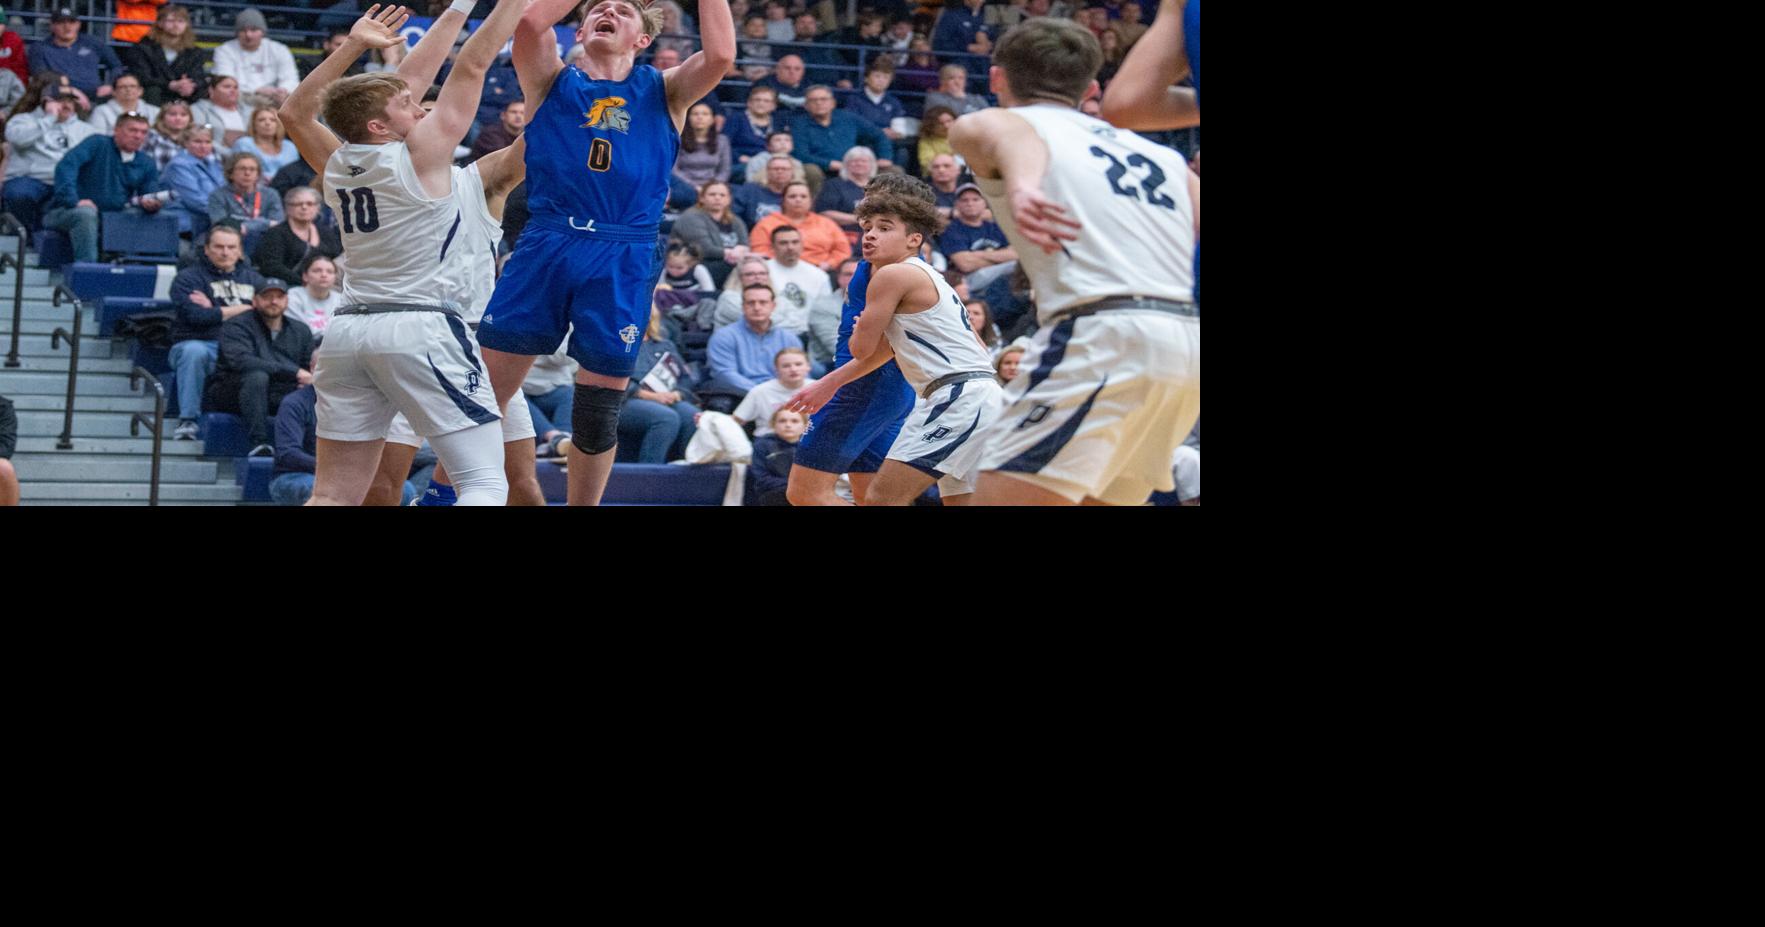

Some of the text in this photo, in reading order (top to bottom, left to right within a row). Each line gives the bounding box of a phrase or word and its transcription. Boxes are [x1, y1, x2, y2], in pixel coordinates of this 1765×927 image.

[587, 137, 612, 172] 0
[1089, 146, 1176, 211] 22
[336, 187, 380, 233] 10
